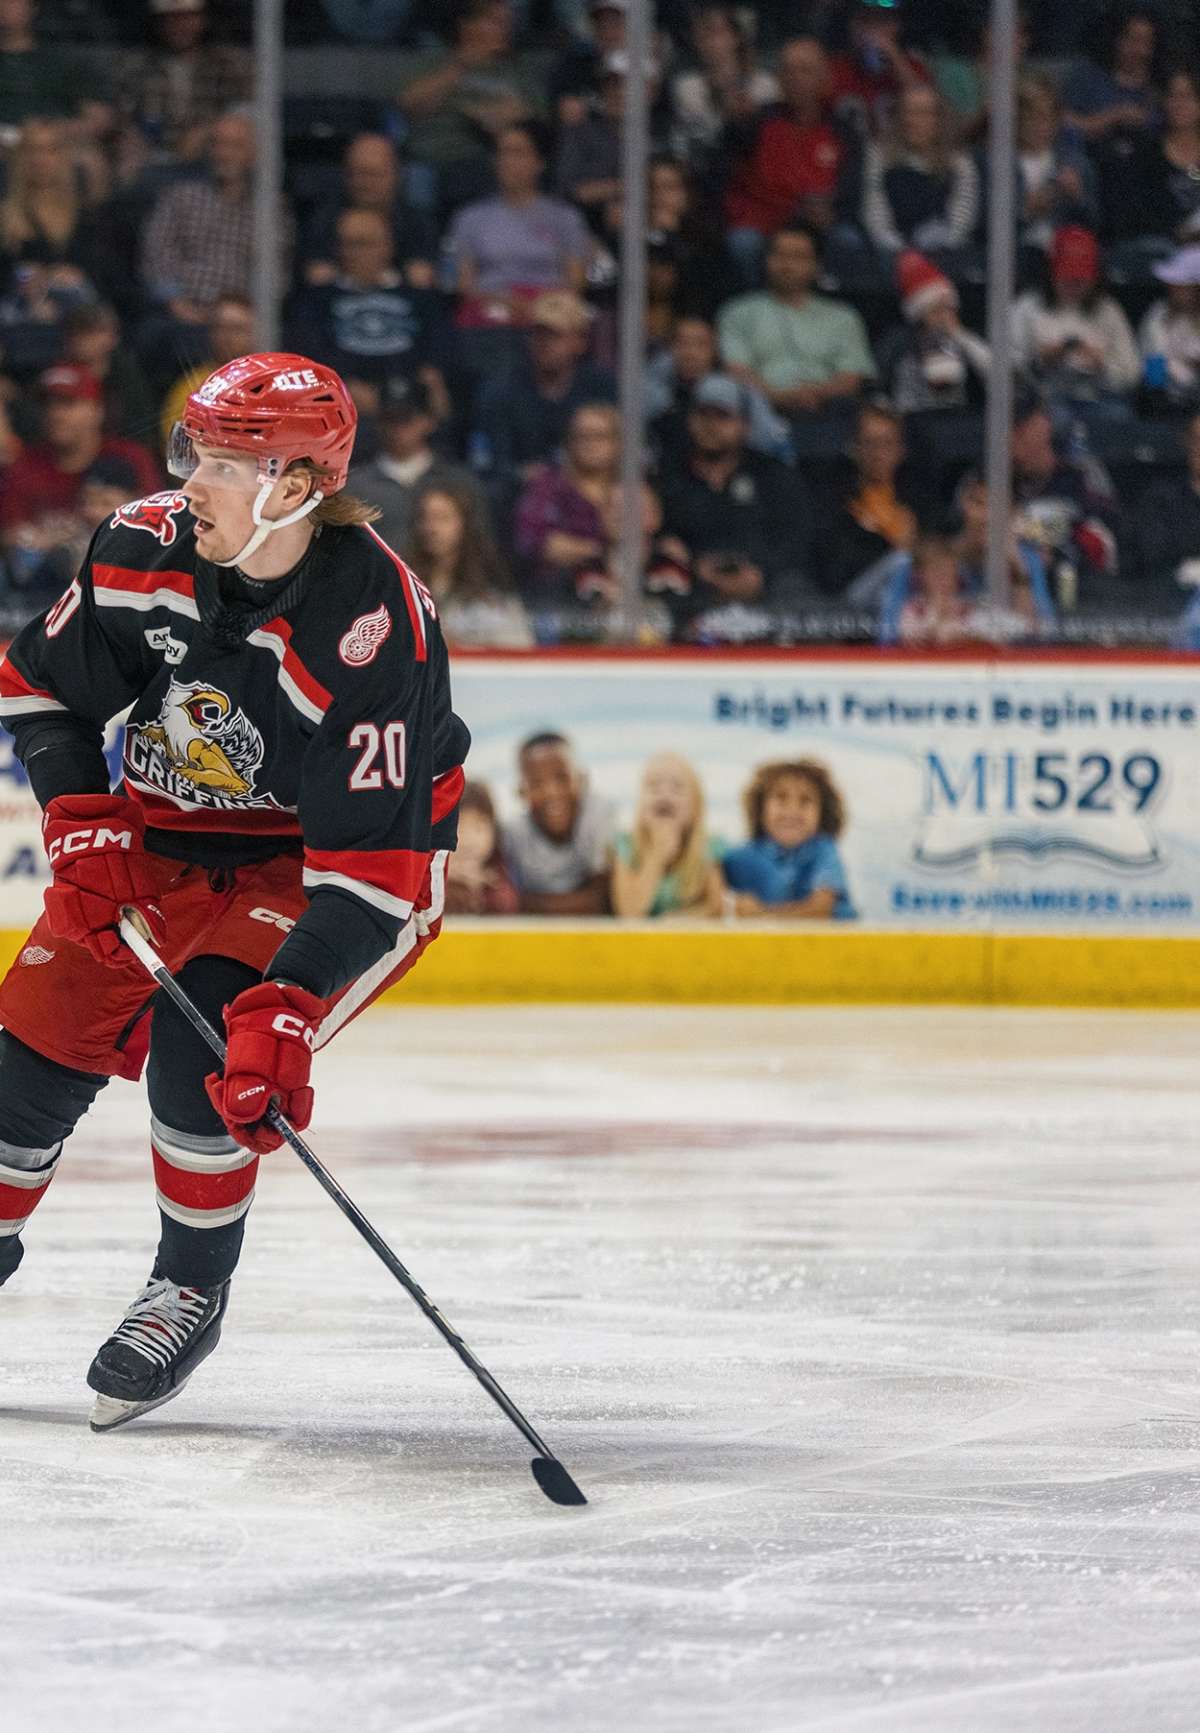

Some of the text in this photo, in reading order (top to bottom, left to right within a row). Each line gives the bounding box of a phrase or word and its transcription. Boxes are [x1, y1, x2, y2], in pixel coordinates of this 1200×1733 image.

[44, 576, 83, 640] 0
[714, 689, 1197, 732] Bright Futures Begin Here
[347, 721, 407, 791] 20
[926, 751, 1164, 813] MI529
[49, 827, 133, 863] CCM
[248, 907, 297, 934] CC
[271, 1013, 315, 1052] CC
[237, 1085, 266, 1101] CCM
